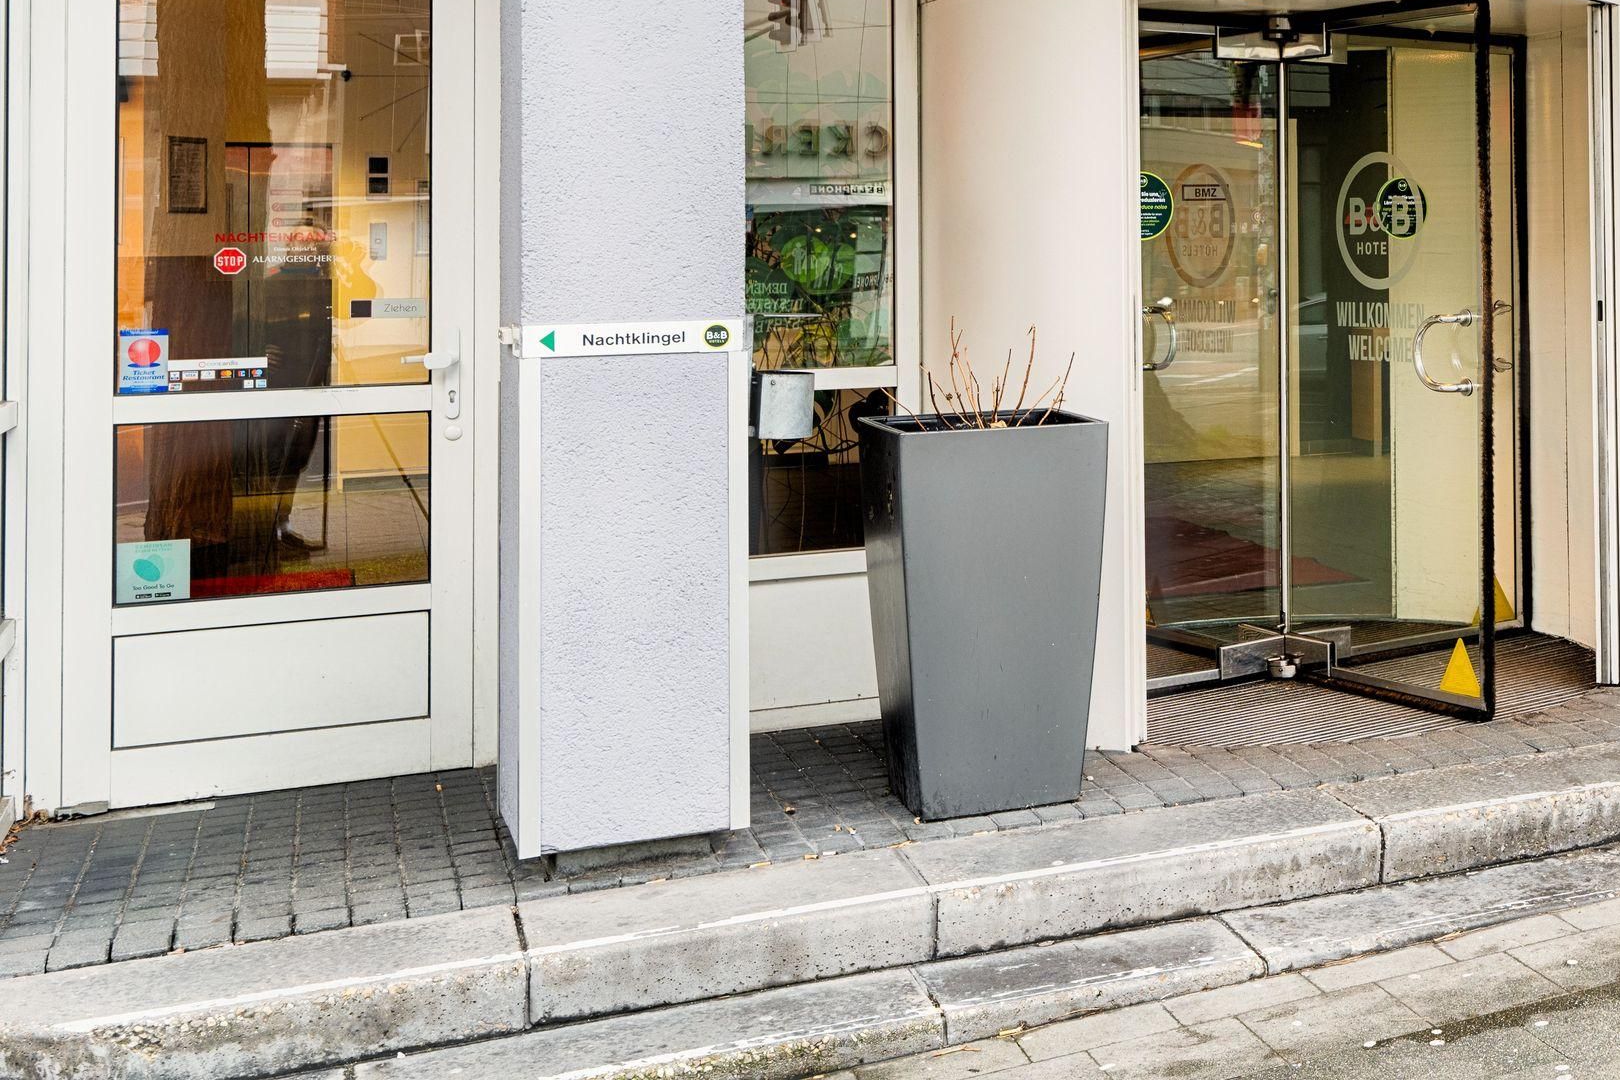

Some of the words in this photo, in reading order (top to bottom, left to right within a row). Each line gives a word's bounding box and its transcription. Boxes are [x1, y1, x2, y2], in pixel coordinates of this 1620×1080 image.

[1349, 197, 1411, 236] B&B
[214, 231, 337, 244] NACHTEINGANG
[1356, 241, 1389, 256] HOTE
[217, 255, 244, 267] STOP
[252, 254, 337, 264] ALARMGESICHERT
[383, 303, 418, 313] Ziehen
[1336, 301, 1425, 329] WILLKOMMEN
[582, 331, 686, 346] Nachtklingel
[706, 330, 728, 340] B&B
[1348, 334, 1413, 363] WELCOME
